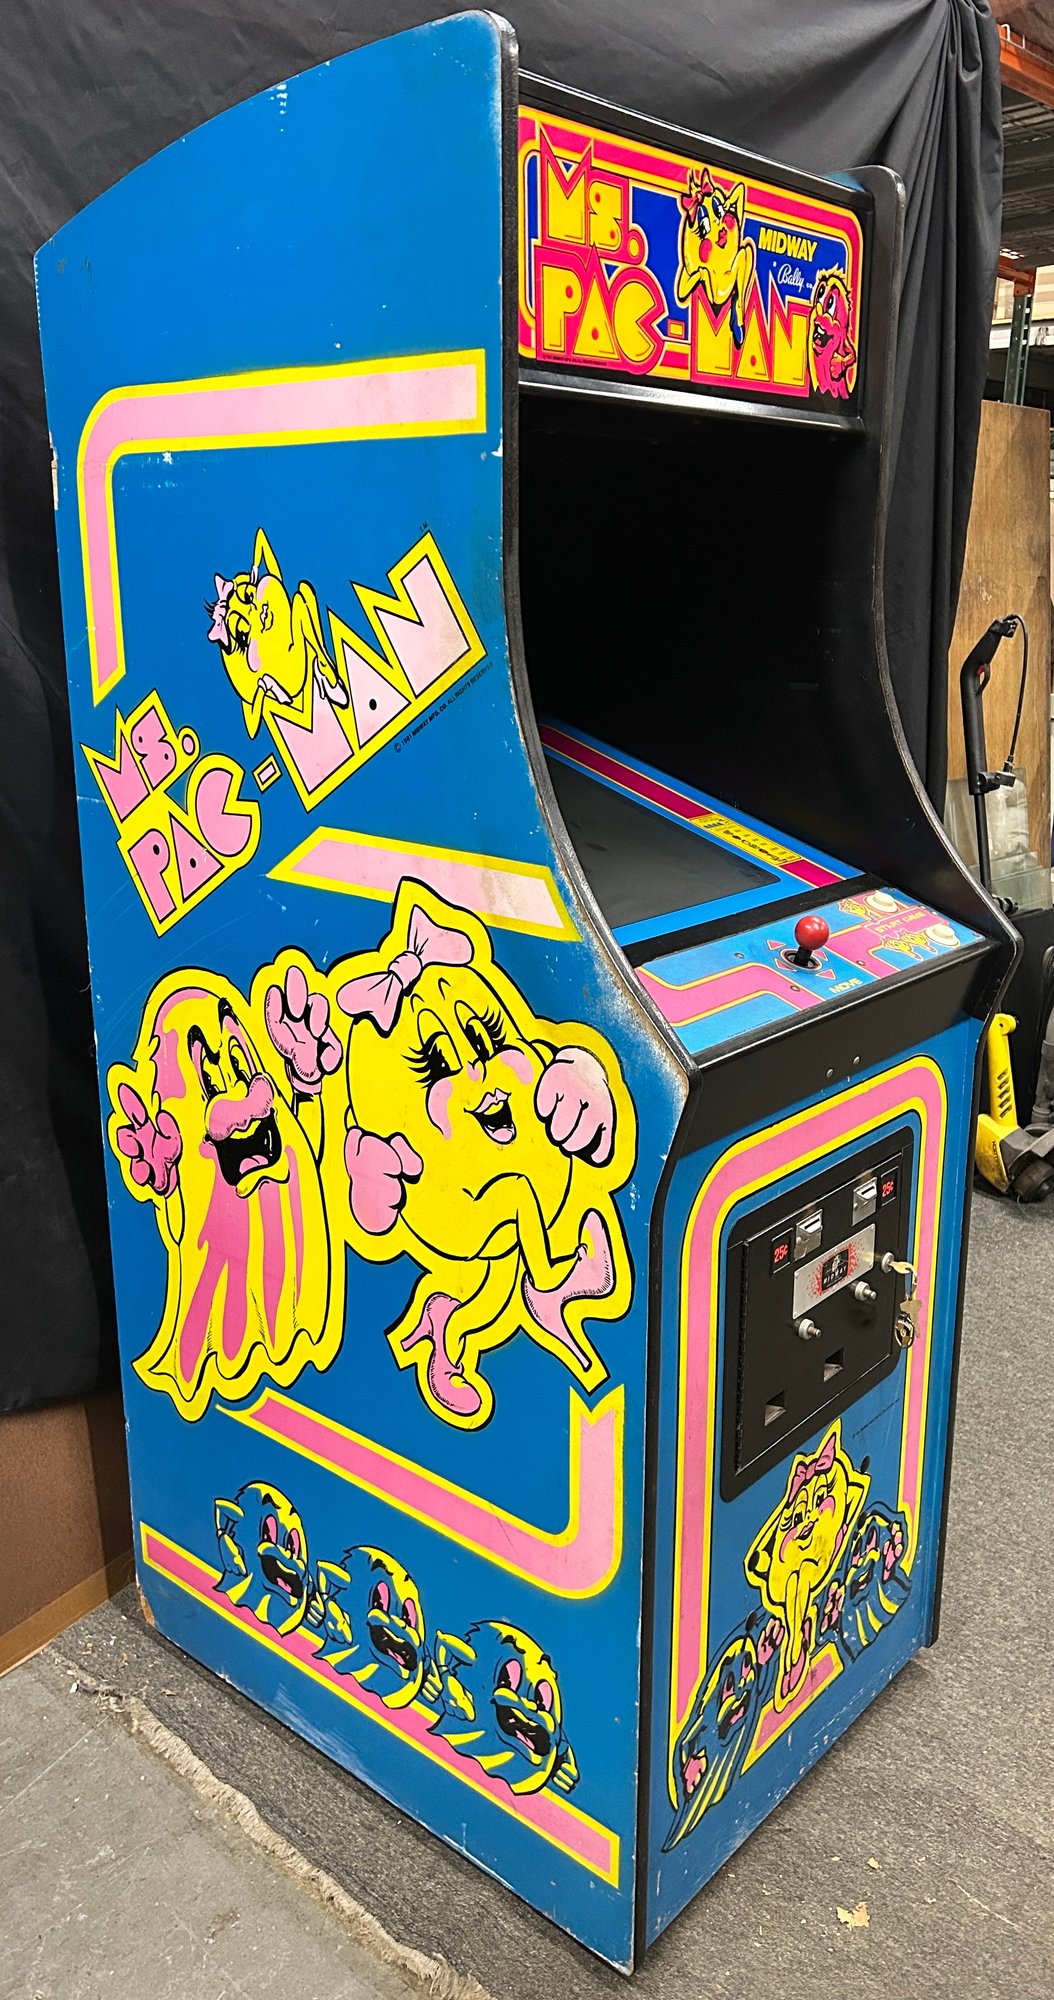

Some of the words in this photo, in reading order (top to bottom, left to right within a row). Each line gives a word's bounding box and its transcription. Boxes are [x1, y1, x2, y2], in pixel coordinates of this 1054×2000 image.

[758, 227, 818, 262] MIDWAY
[778, 264, 804, 293] Bally
[402, 734, 413, 745] 1981
[412, 719, 430, 737] MIDWAY
[428, 709, 440, 722] MFG.
[439, 702, 448, 712] CO.
[447, 696, 456, 706] ALL
[455, 682, 471, 698] RIGHTS
[470, 661, 494, 685] RESERVED
[874, 919, 903, 933] START
[829, 977, 864, 993] MOVE
[881, 1180, 894, 1198] 25¢
[773, 1243, 789, 1264] 25¢
[823, 1265, 847, 1285] MIDWAY
